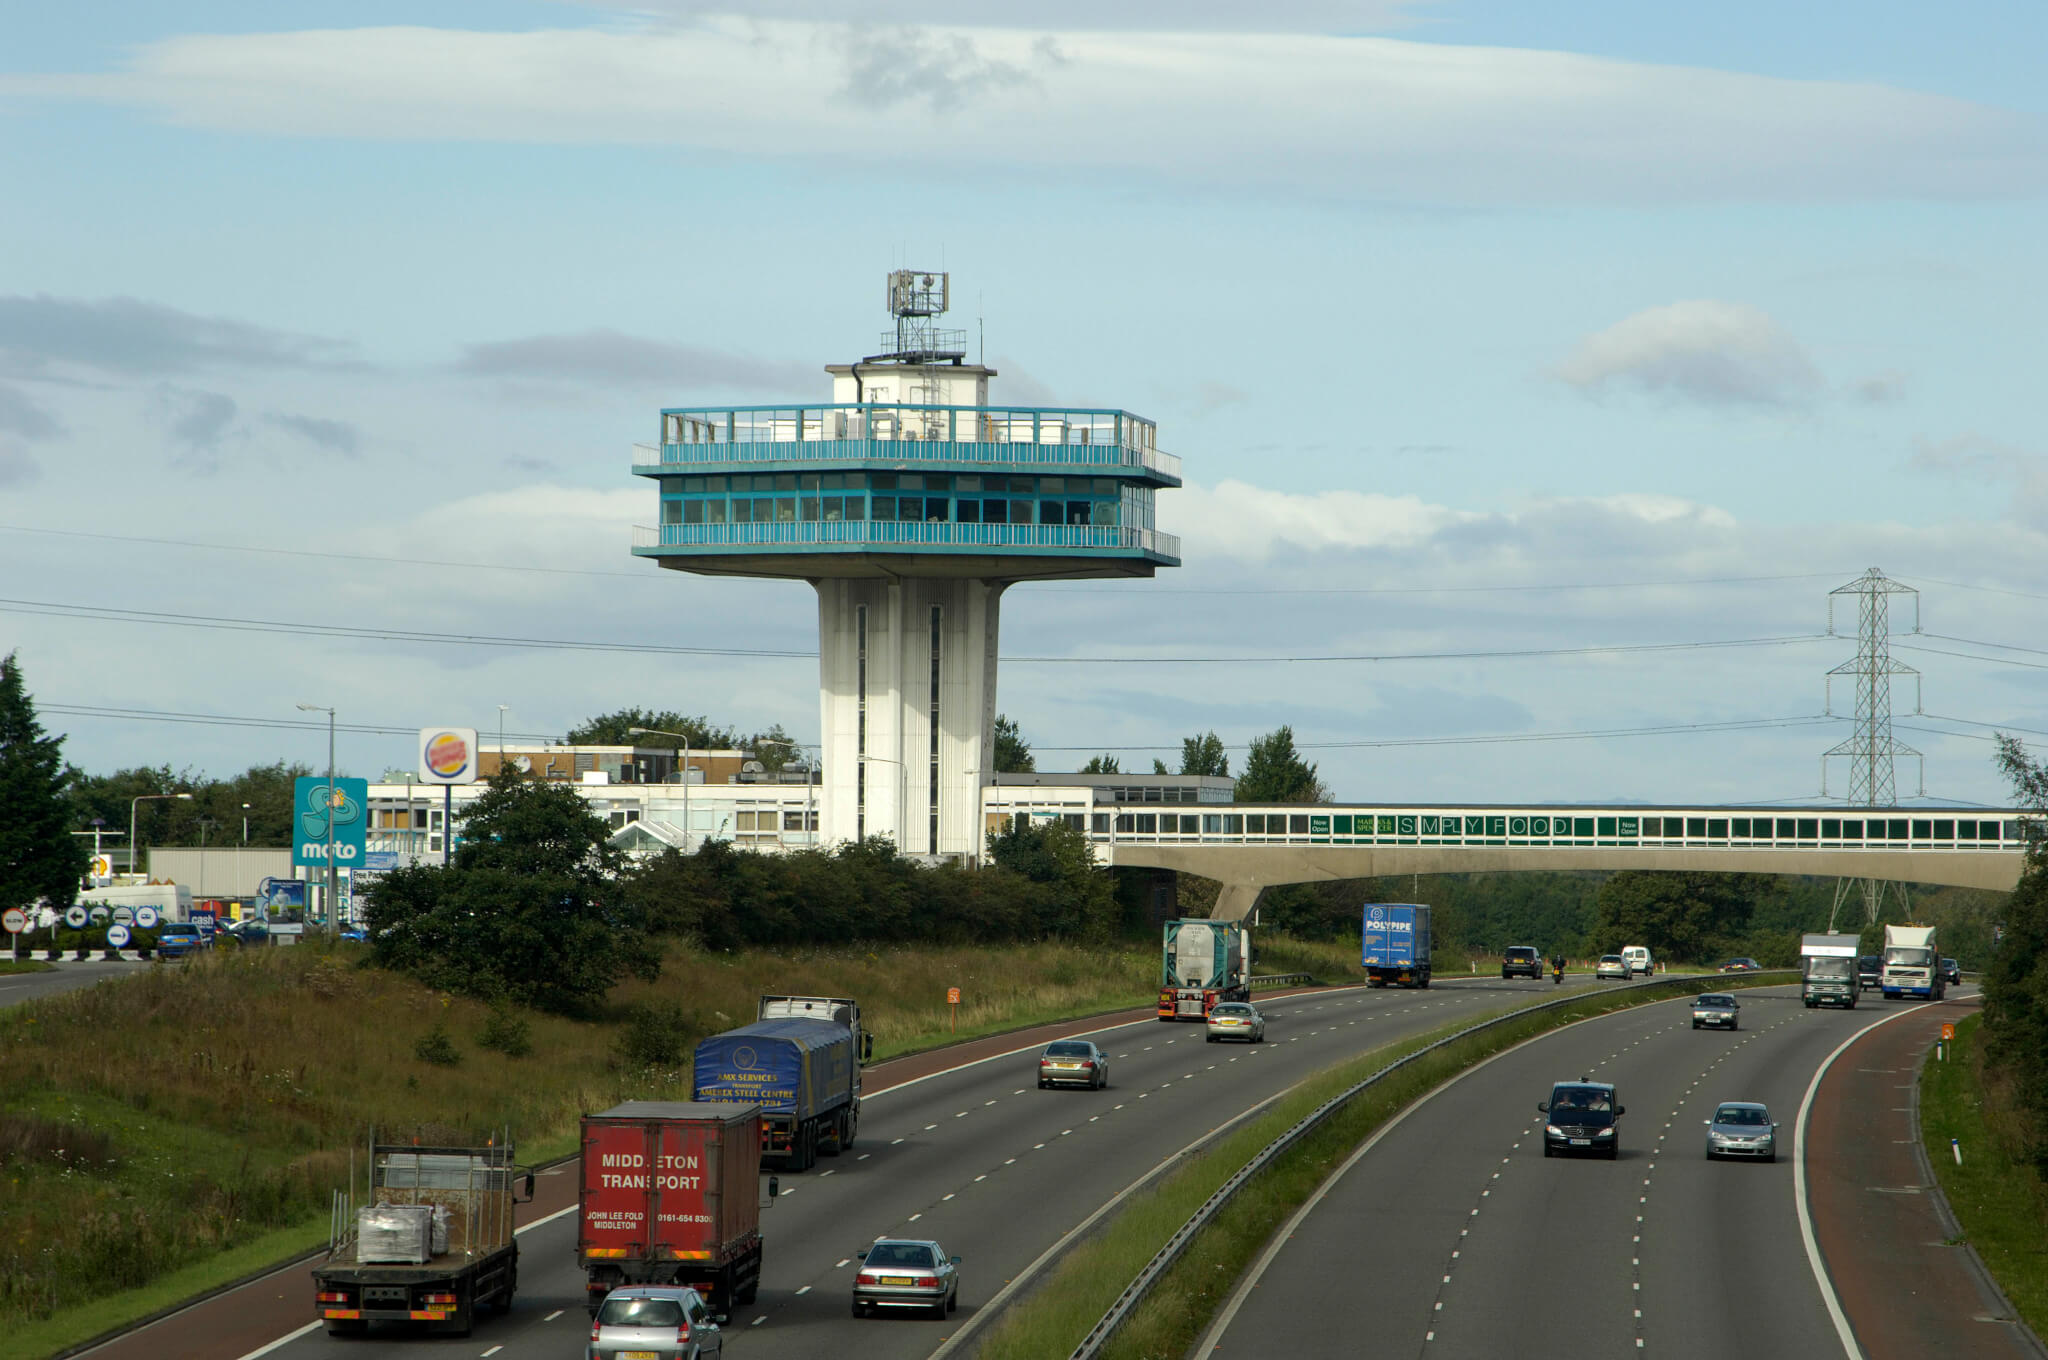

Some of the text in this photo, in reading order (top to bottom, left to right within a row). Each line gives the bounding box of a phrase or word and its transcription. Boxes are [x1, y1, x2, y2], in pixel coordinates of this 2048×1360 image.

[1311, 825, 1328, 833] Open
[1401, 817, 1567, 834] SIMPLY FOOD
[302, 840, 357, 859] moto
[191, 914, 214, 926] cash
[1367, 920, 1412, 931] POLYPIPE
[738, 1073, 777, 1081] SERVICES
[735, 1089, 758, 1097] STEEL
[761, 1090, 794, 1098] CENTRE
[602, 1153, 698, 1169] MIDDETON
[587, 1211, 607, 1220] JOHN
[609, 1211, 623, 1220] LEE
[625, 1212, 644, 1220] FOLD
[594, 1221, 637, 1230] MIDDLETON
